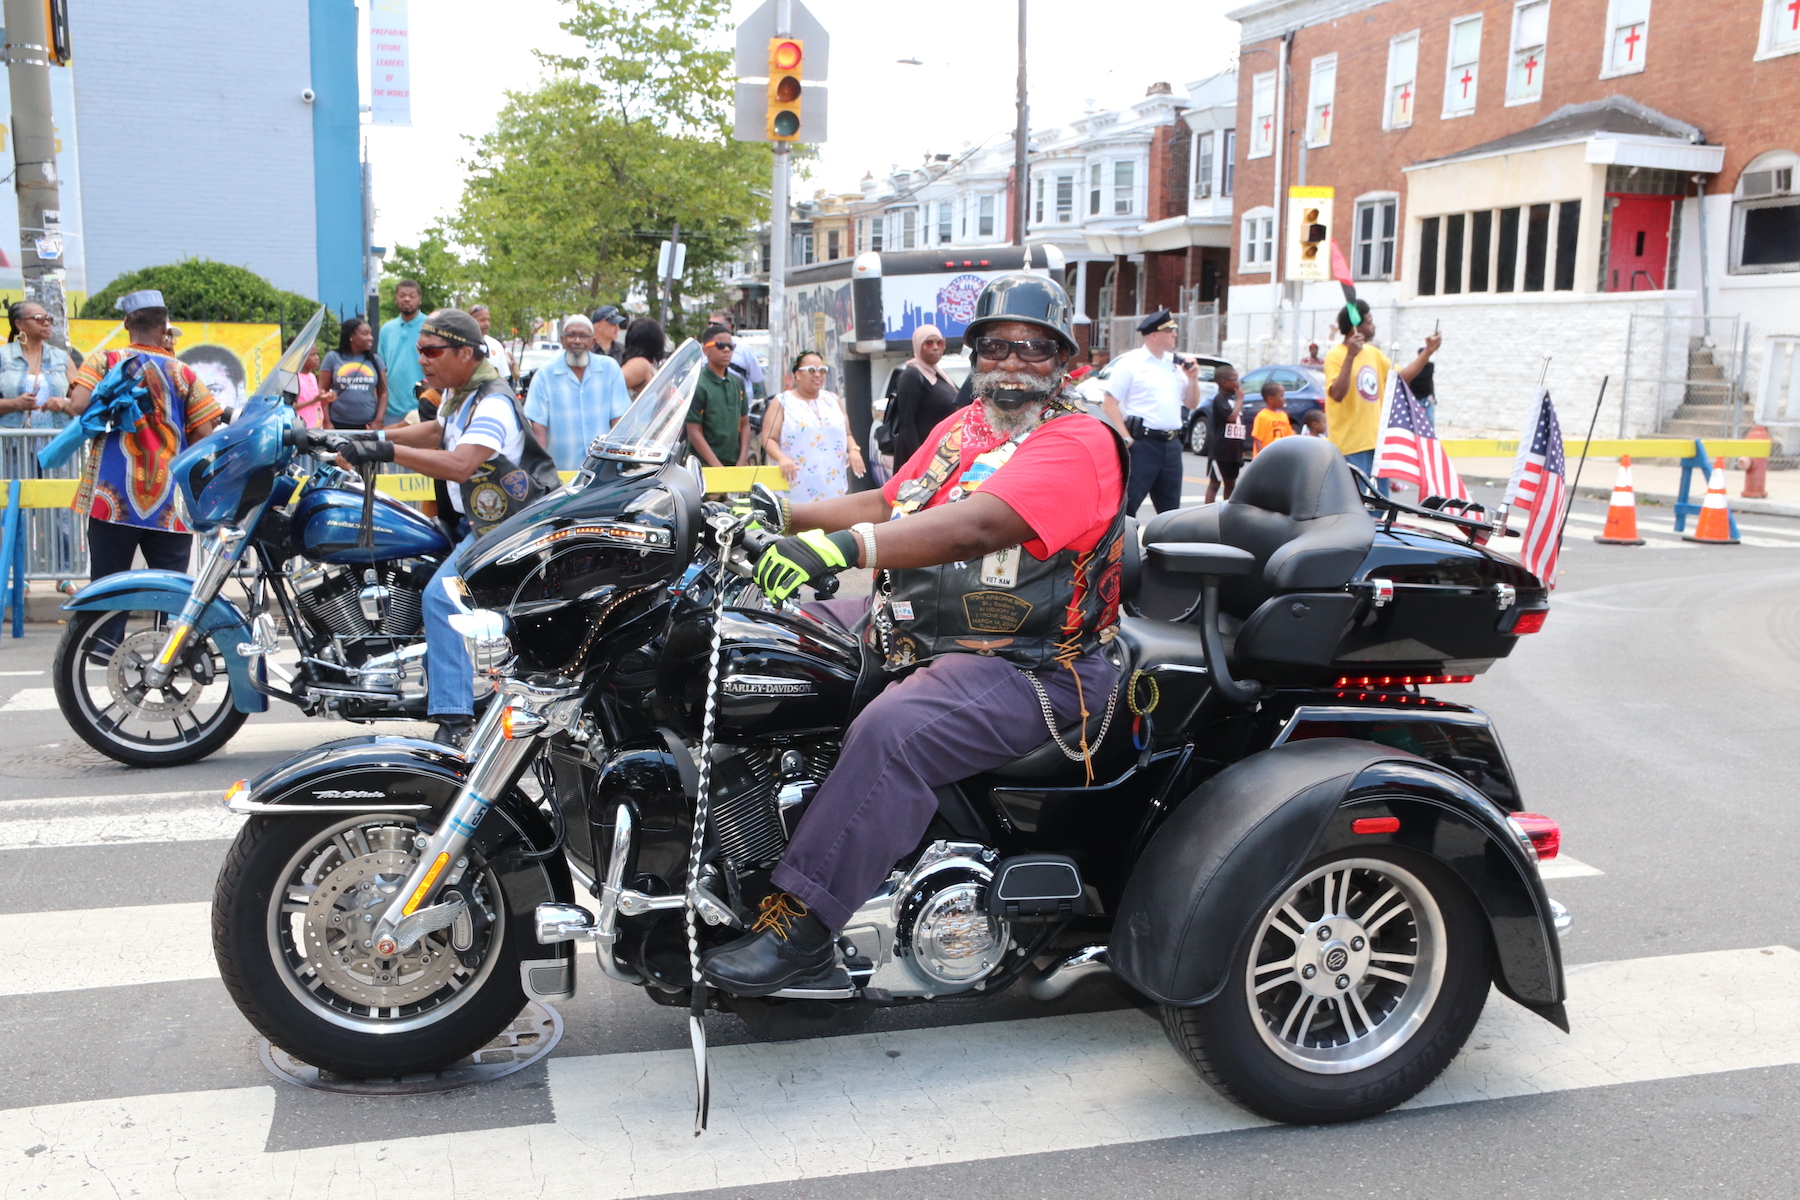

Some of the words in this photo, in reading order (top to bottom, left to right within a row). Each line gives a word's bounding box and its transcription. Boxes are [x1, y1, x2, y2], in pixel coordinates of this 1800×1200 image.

[371, 28, 408, 36] PREPARING
[376, 43, 401, 52] FUTURE
[376, 59, 404, 67] LEADERS
[385, 74, 394, 82] OF
[373, 89, 385, 97] THE
[386, 89, 409, 98] WORLD
[986, 576, 997, 584] VIET
[722, 683, 812, 693] HARLEY-DAVIDSON
